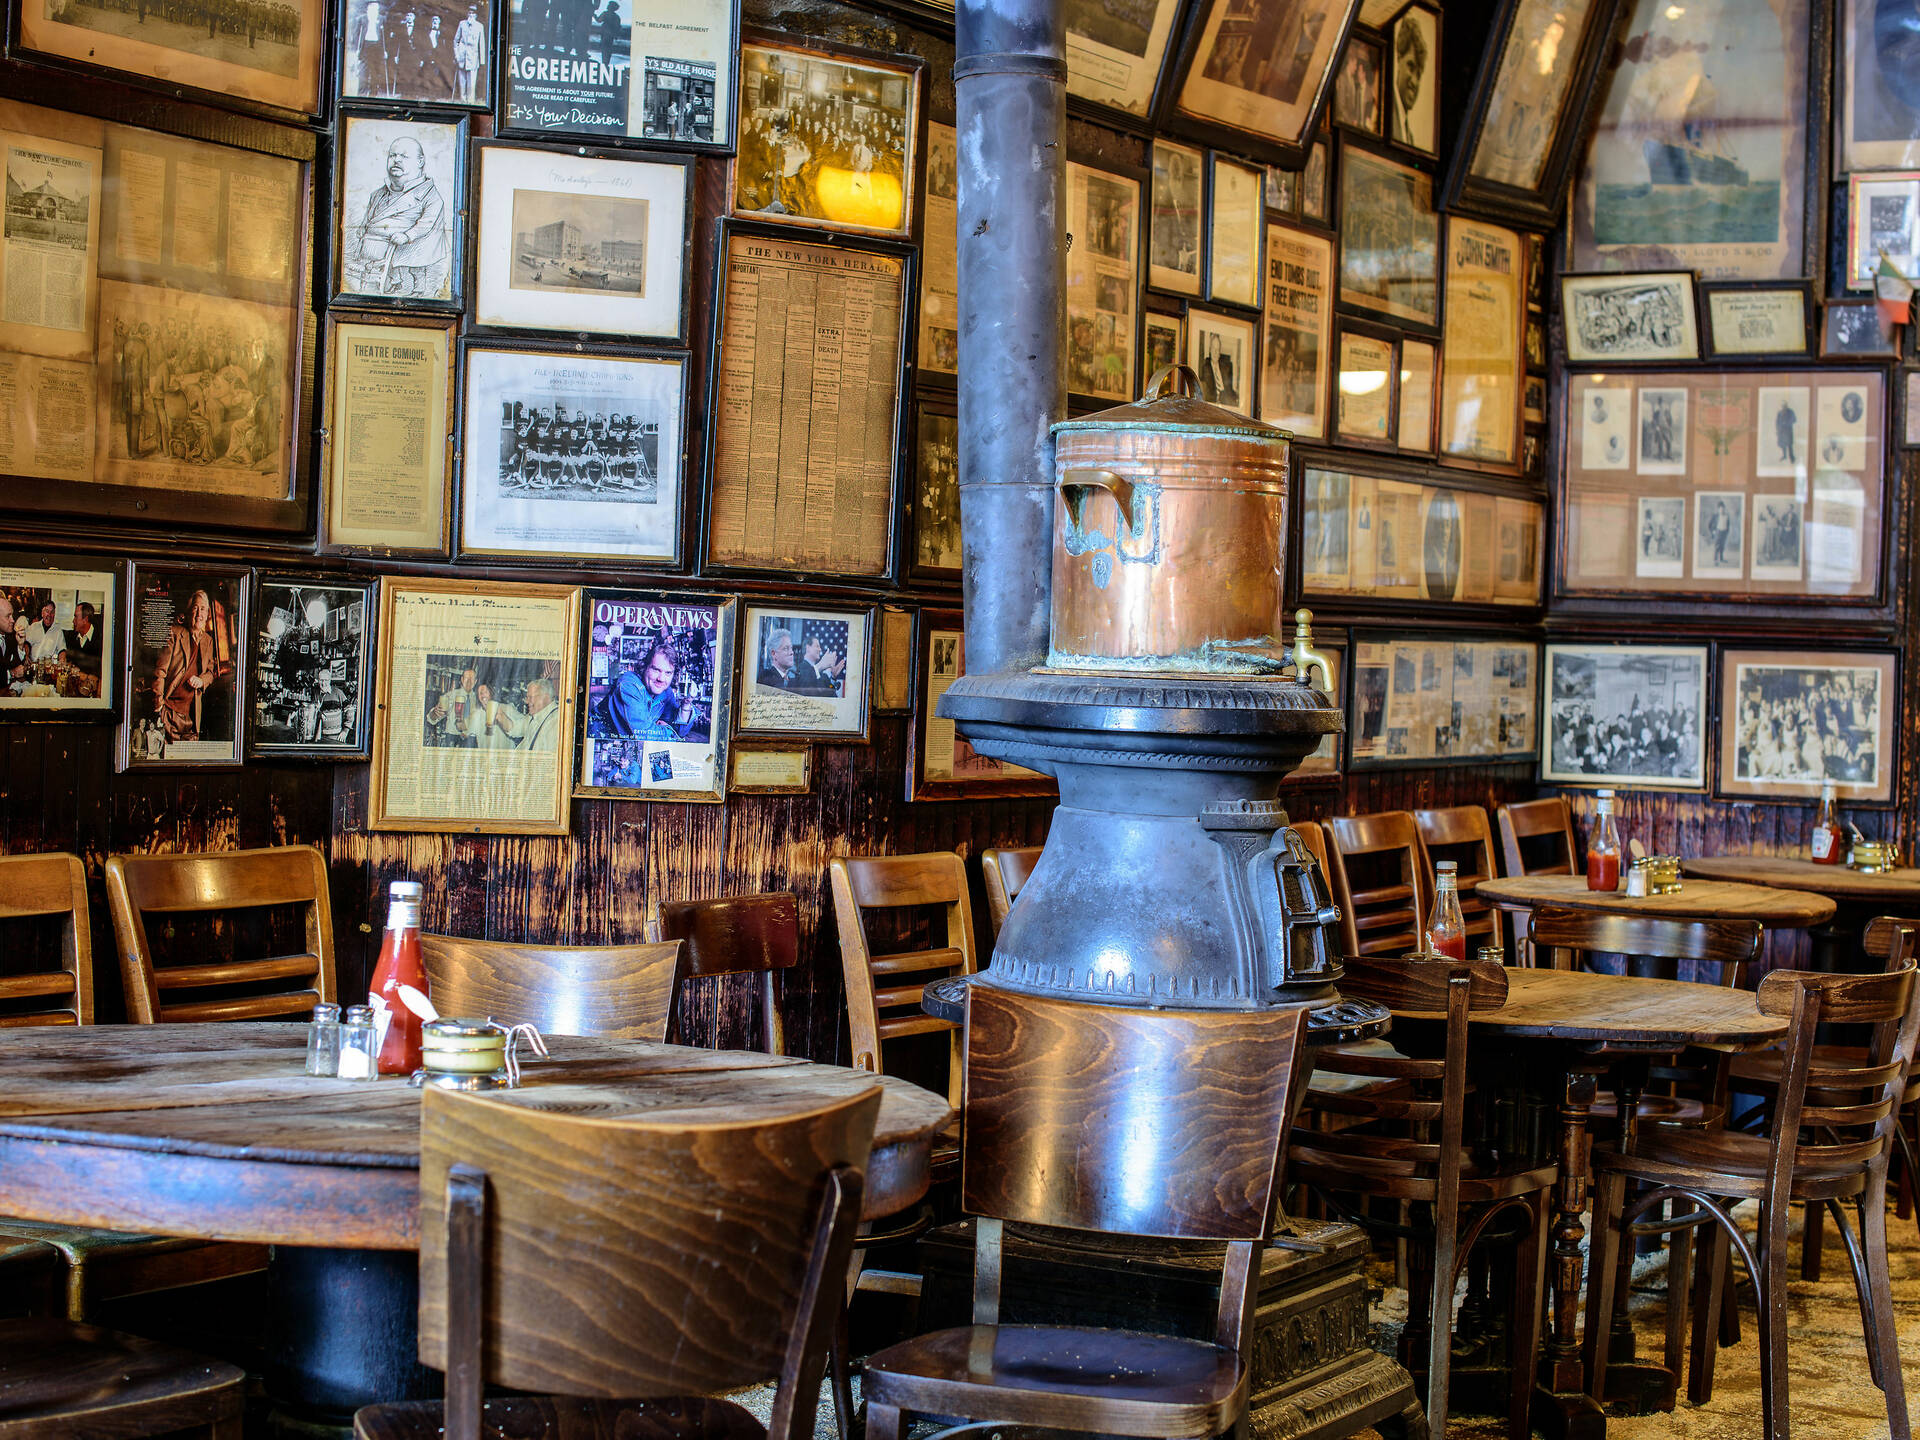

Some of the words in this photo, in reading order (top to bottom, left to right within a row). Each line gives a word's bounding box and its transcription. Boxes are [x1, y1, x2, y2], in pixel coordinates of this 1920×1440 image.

[675, 25, 709, 33] AGREEMENT
[508, 55, 623, 87] AGREEMENT
[661, 61, 675, 69] OLD
[676, 63, 690, 72] ALE
[691, 66, 717, 79] HOUSE
[506, 103, 534, 120] It's
[534, 104, 570, 125] Your
[571, 108, 624, 126] Decision
[746, 247, 771, 257] THE
[776, 250, 802, 261] NEW
[807, 254, 838, 266] YORK
[1457, 235, 1483, 267] JOHN
[1485, 243, 1511, 275] SMITH
[1694, 248, 1728, 256] LLOYD
[1272, 284, 1287, 306] FREE
[354, 344, 389, 358] THEATRE
[392, 347, 427, 362] COMIQUE,
[818, 346, 839, 354] DEATH
[596, 602, 666, 630] OPERA
[660, 606, 713, 630] NEWS
[455, 646, 474, 654] Speaker
